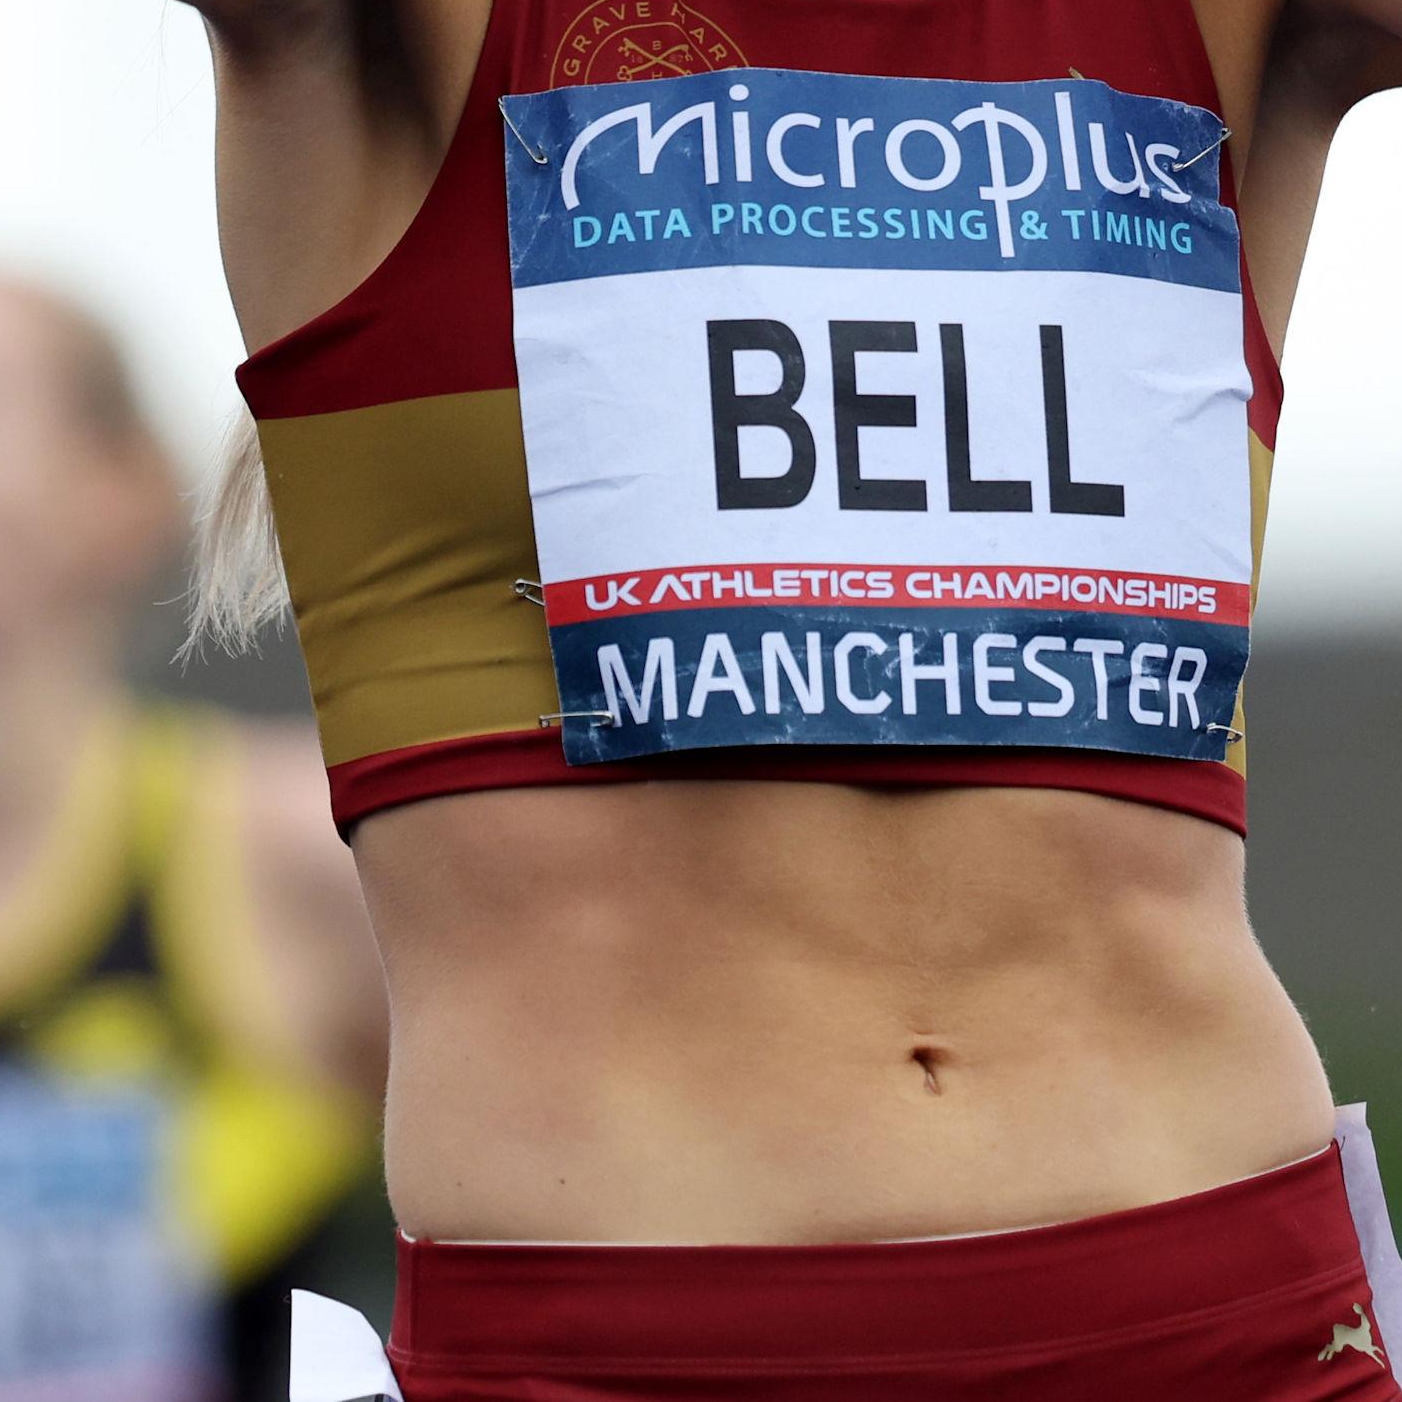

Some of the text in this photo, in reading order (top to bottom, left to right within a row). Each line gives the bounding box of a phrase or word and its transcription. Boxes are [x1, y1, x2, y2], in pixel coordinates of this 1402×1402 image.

[572, 202, 1194, 255] DATA PROCESSING & TIMING
[705, 318, 1126, 518] BELL
[583, 570, 1217, 614] UK ATHLETICS CHAMPIONSHIPS
[596, 631, 1209, 729] MANCHESTER
